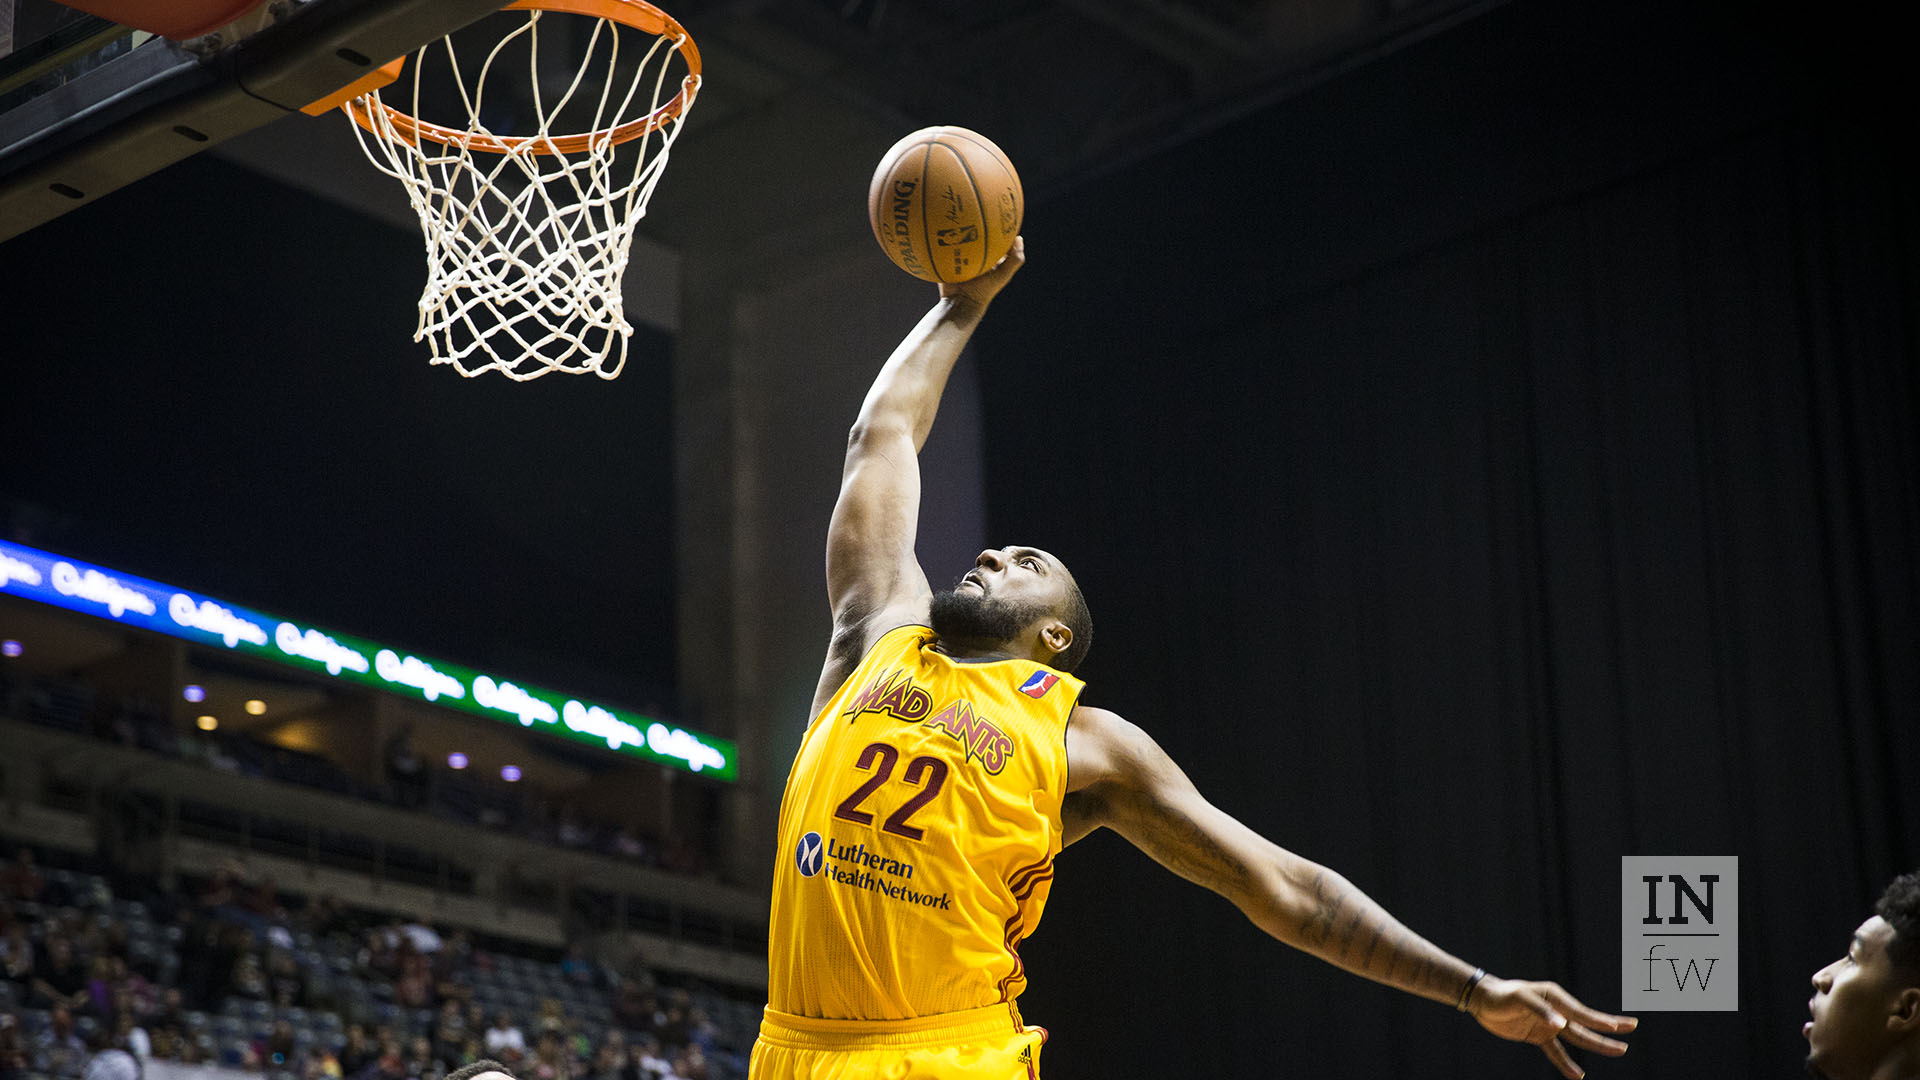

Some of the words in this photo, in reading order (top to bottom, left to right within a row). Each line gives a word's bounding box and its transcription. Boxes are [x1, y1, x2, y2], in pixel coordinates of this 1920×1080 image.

[843, 669, 933, 724] MAD
[922, 699, 1015, 776] ANTS
[834, 742, 949, 842] 22
[824, 862, 875, 892] Health
[876, 876, 952, 911] Network
[828, 838, 913, 880] Lutheran
